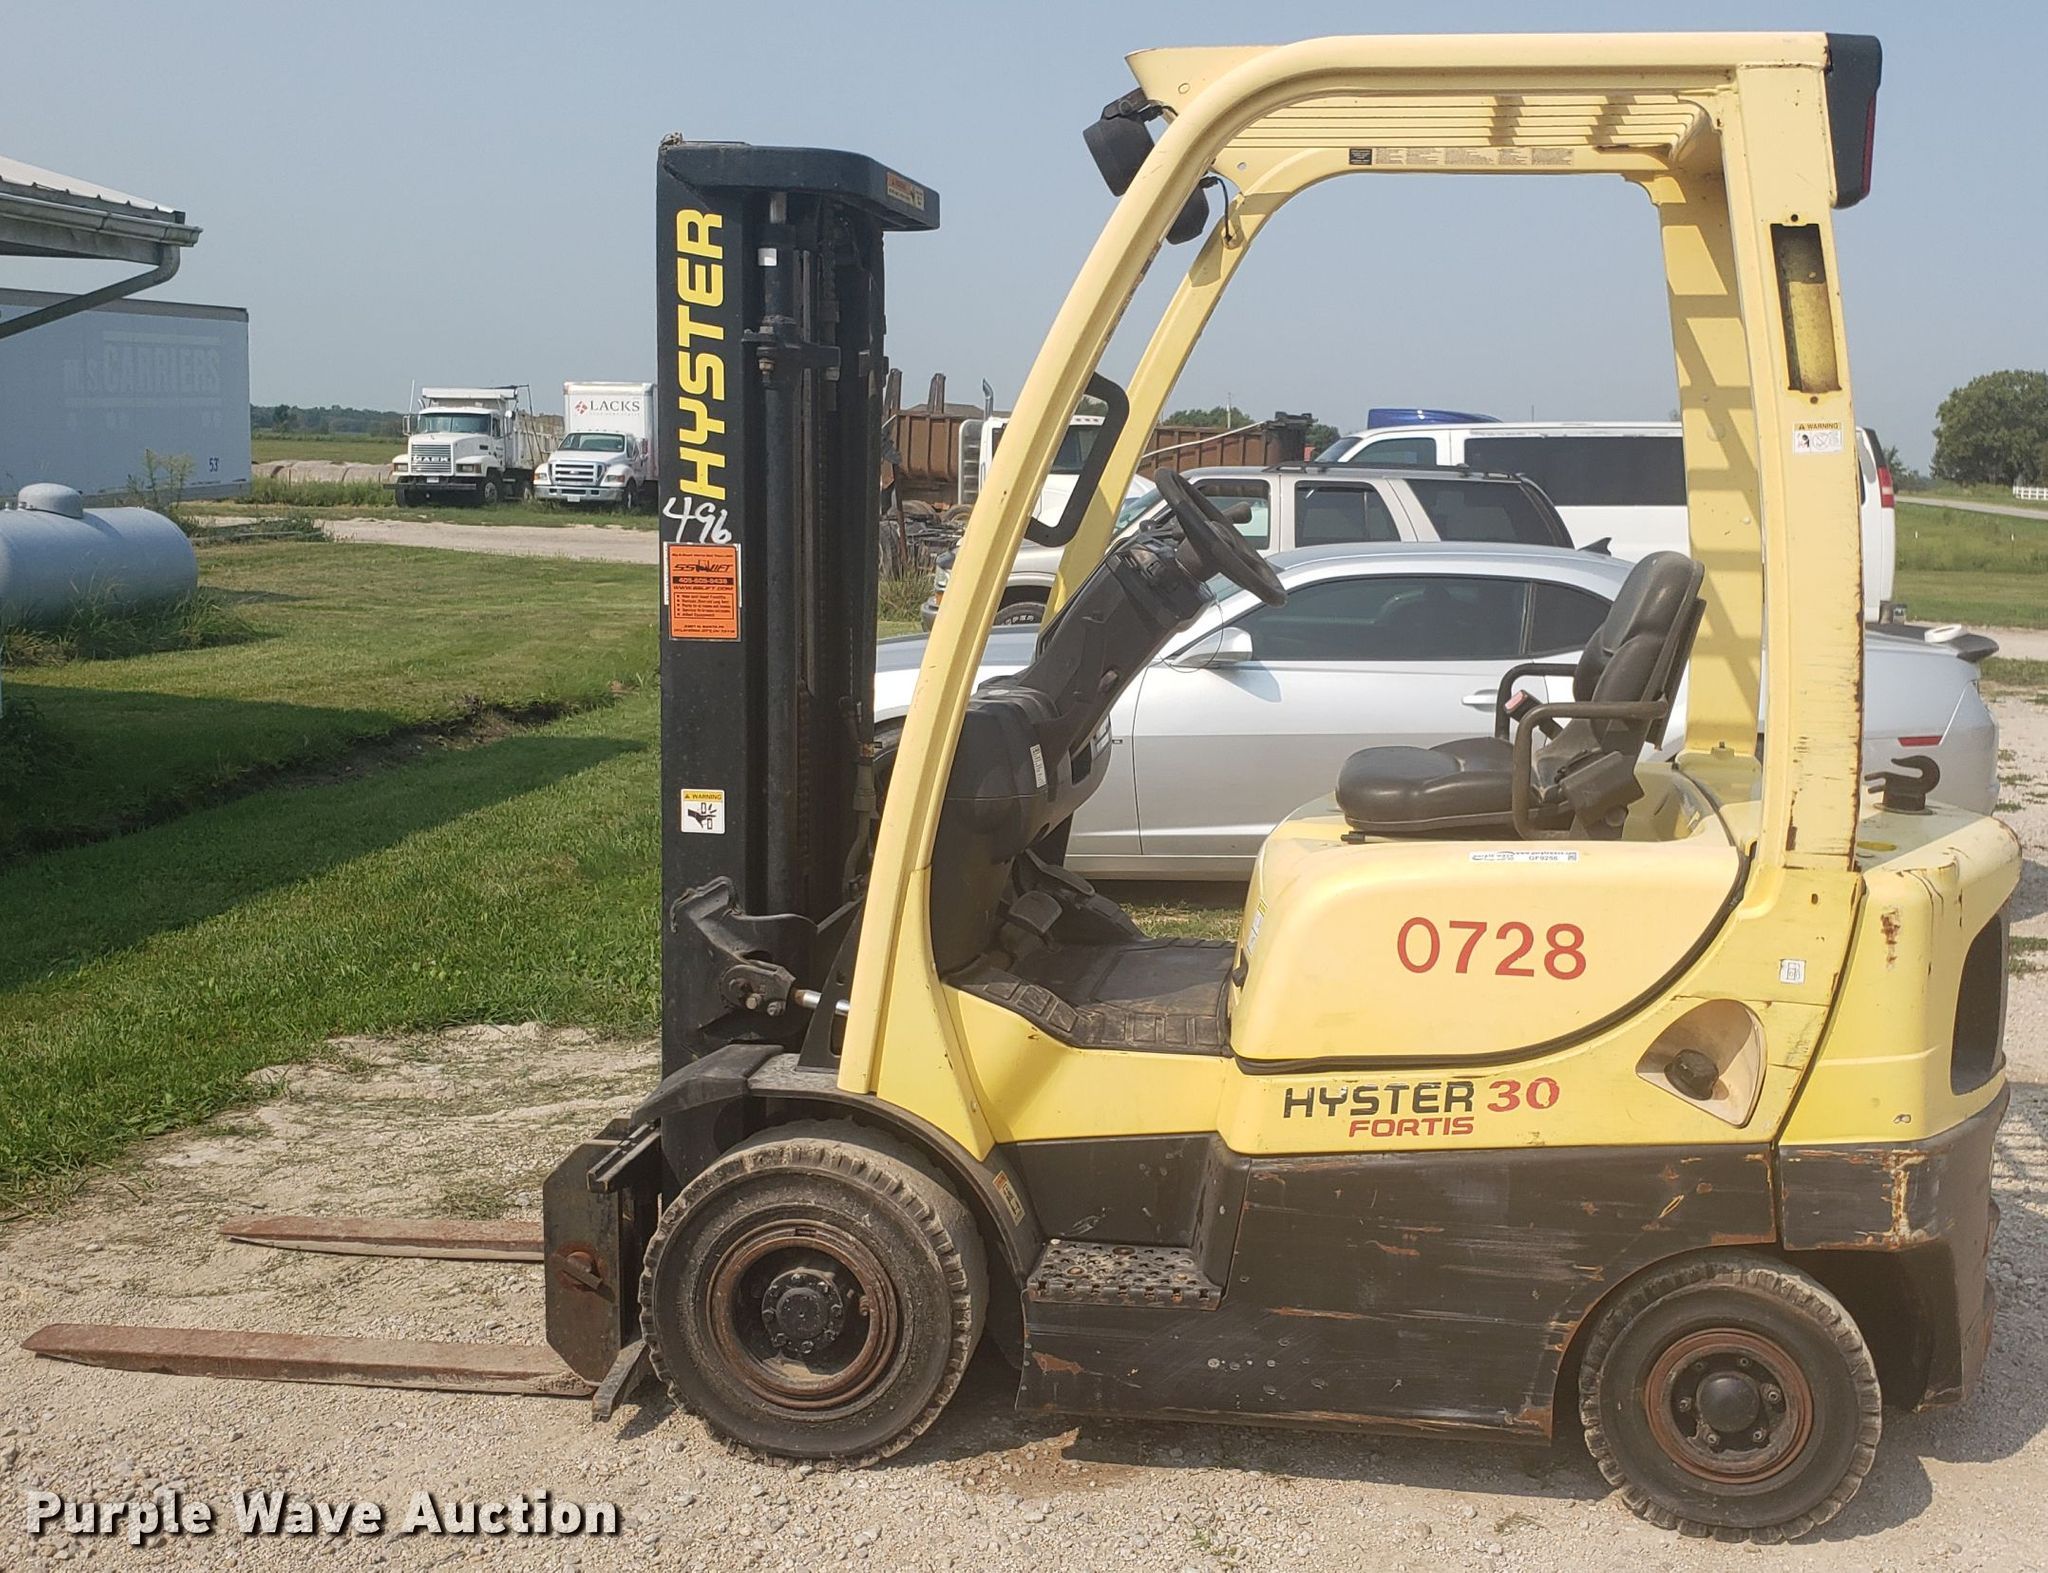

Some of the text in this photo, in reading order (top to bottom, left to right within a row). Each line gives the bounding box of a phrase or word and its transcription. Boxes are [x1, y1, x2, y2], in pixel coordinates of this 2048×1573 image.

[677, 208, 726, 500] HYSTER
[590, 400, 640, 412] LACKS
[663, 496, 733, 544] 496
[1397, 916, 1587, 980] 0728
[1283, 1077, 1560, 1118] HYSTER 30
[1349, 1116, 1475, 1138] FORTIS
